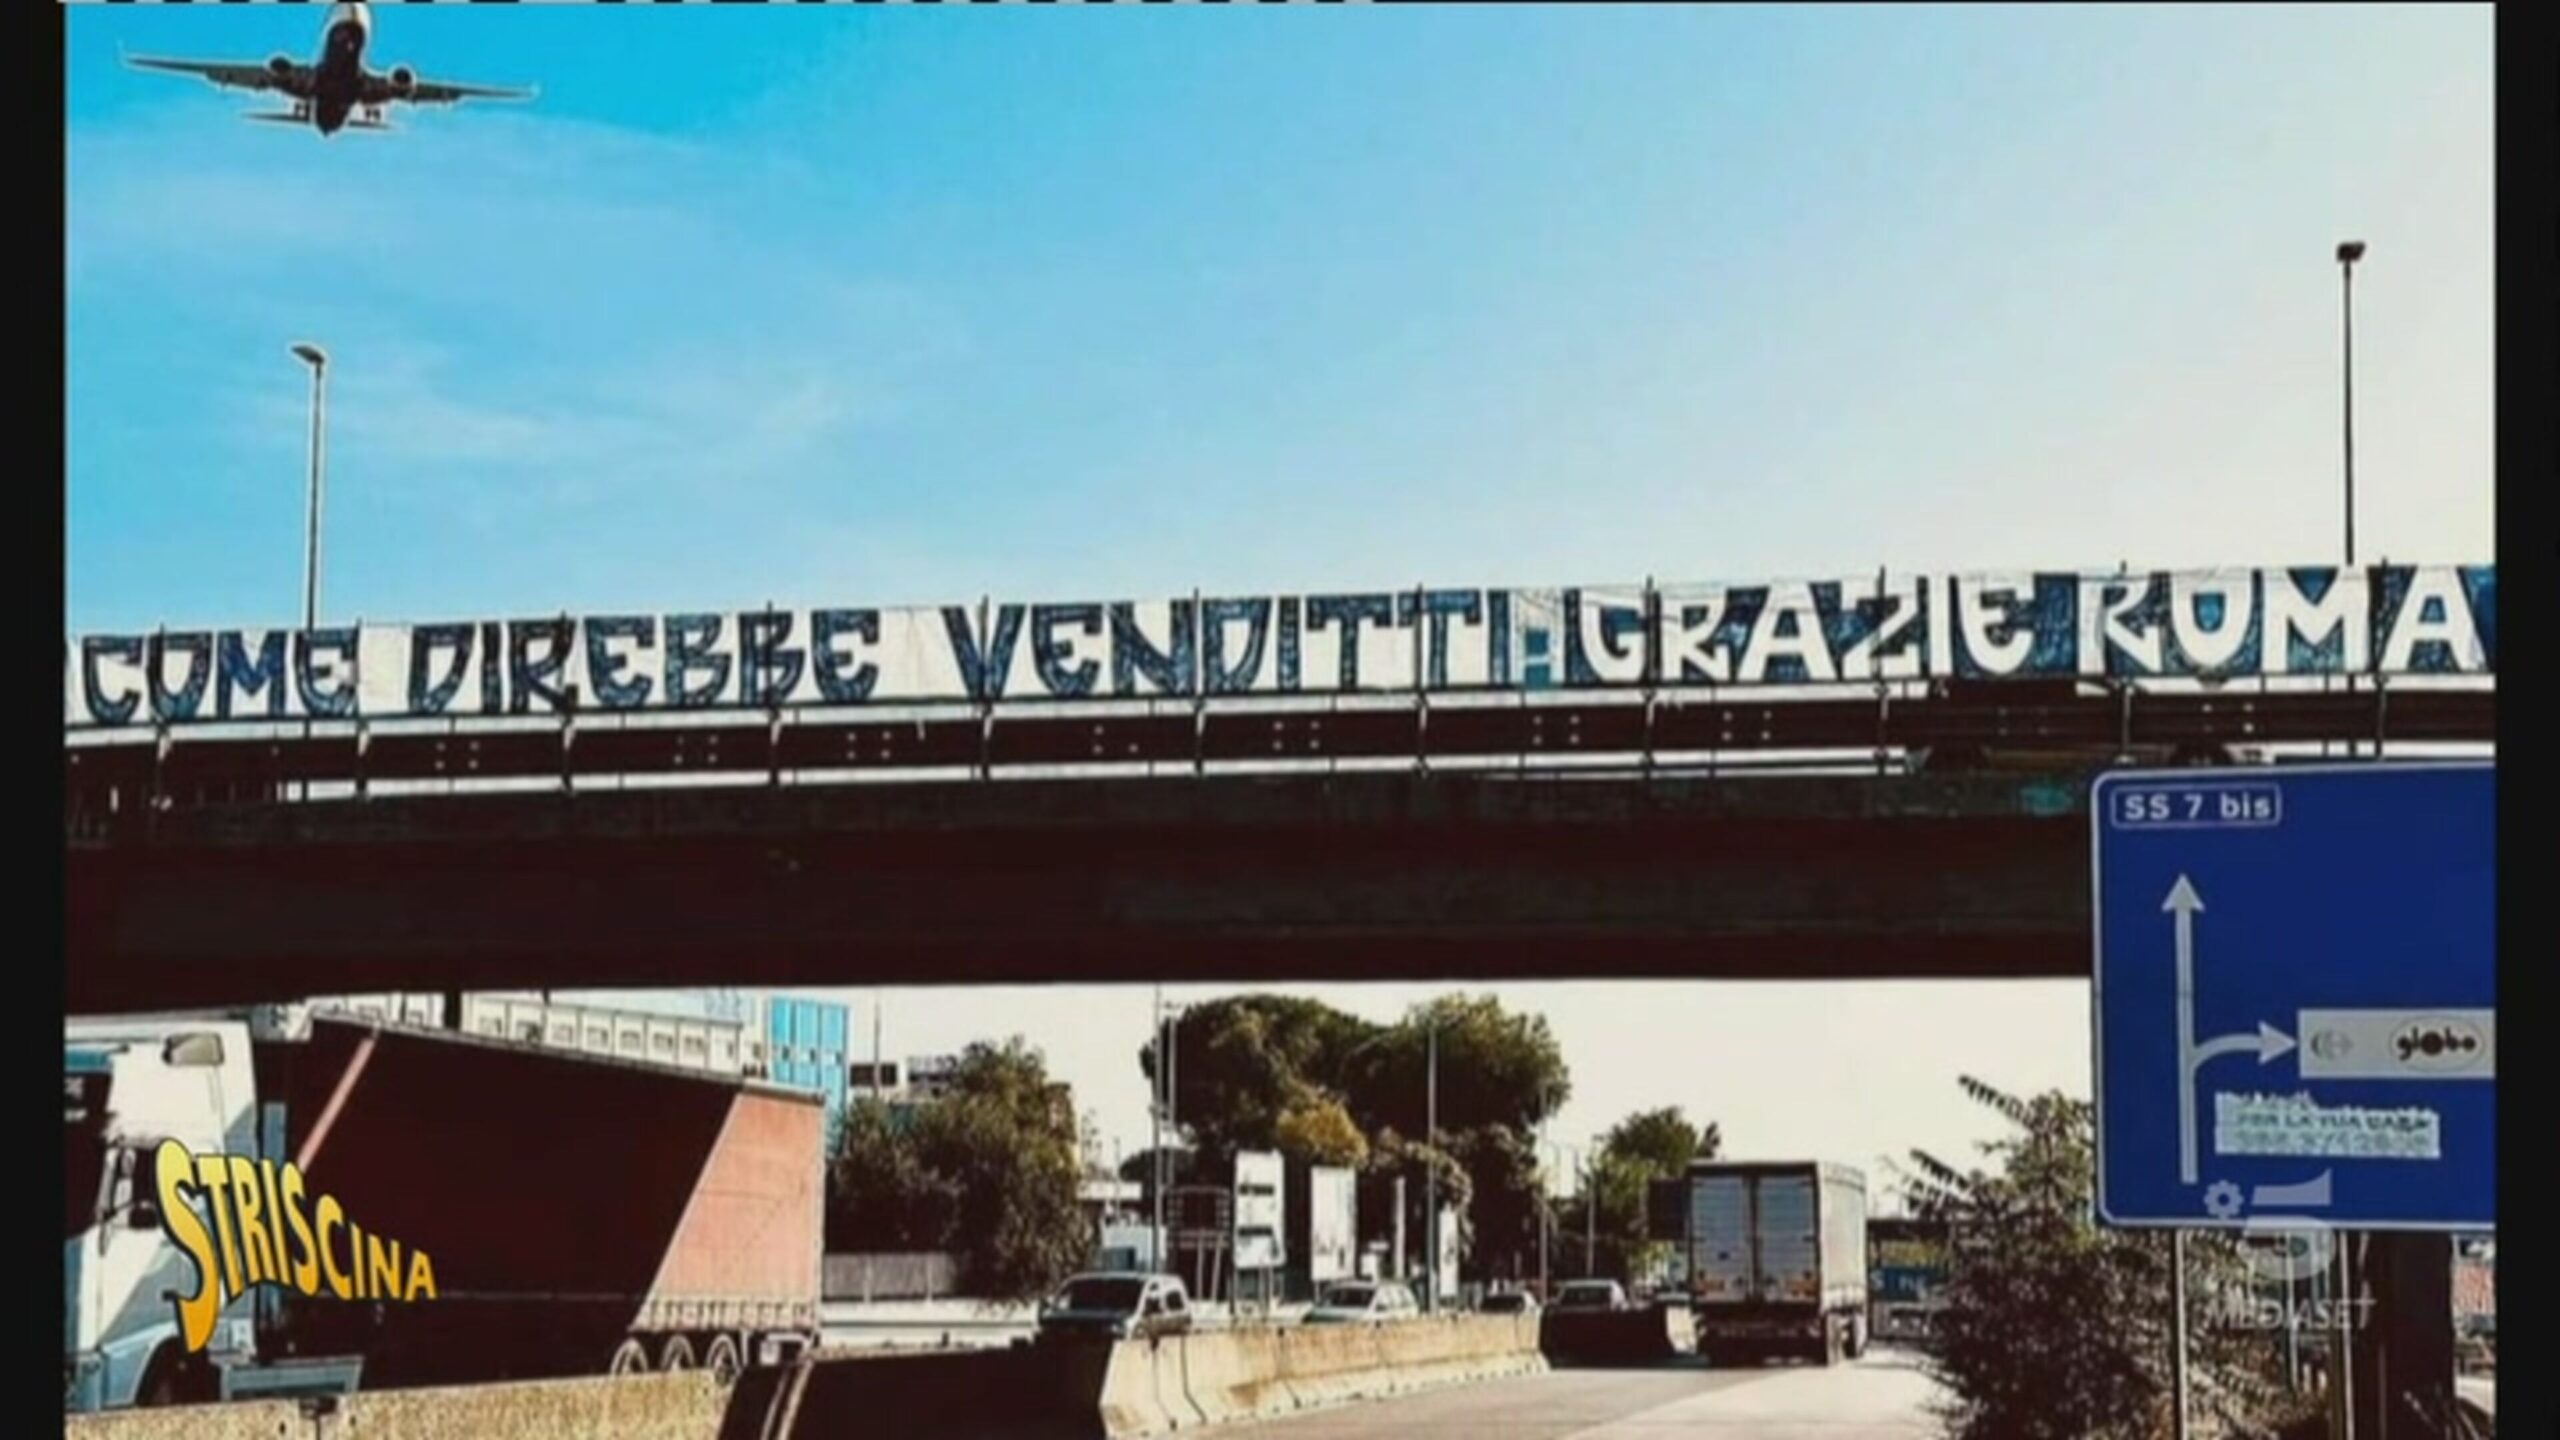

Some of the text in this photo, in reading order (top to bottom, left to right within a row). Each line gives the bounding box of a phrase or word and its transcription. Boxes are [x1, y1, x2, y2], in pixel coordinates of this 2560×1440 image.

[82, 628, 360, 724] COME
[408, 608, 881, 716] DIREBBE
[1580, 572, 2036, 684] GRAZIE
[2077, 565, 2488, 675] ROMA
[2125, 792, 2272, 820] SS 7 bis
[2397, 1027, 2476, 1061] globo
